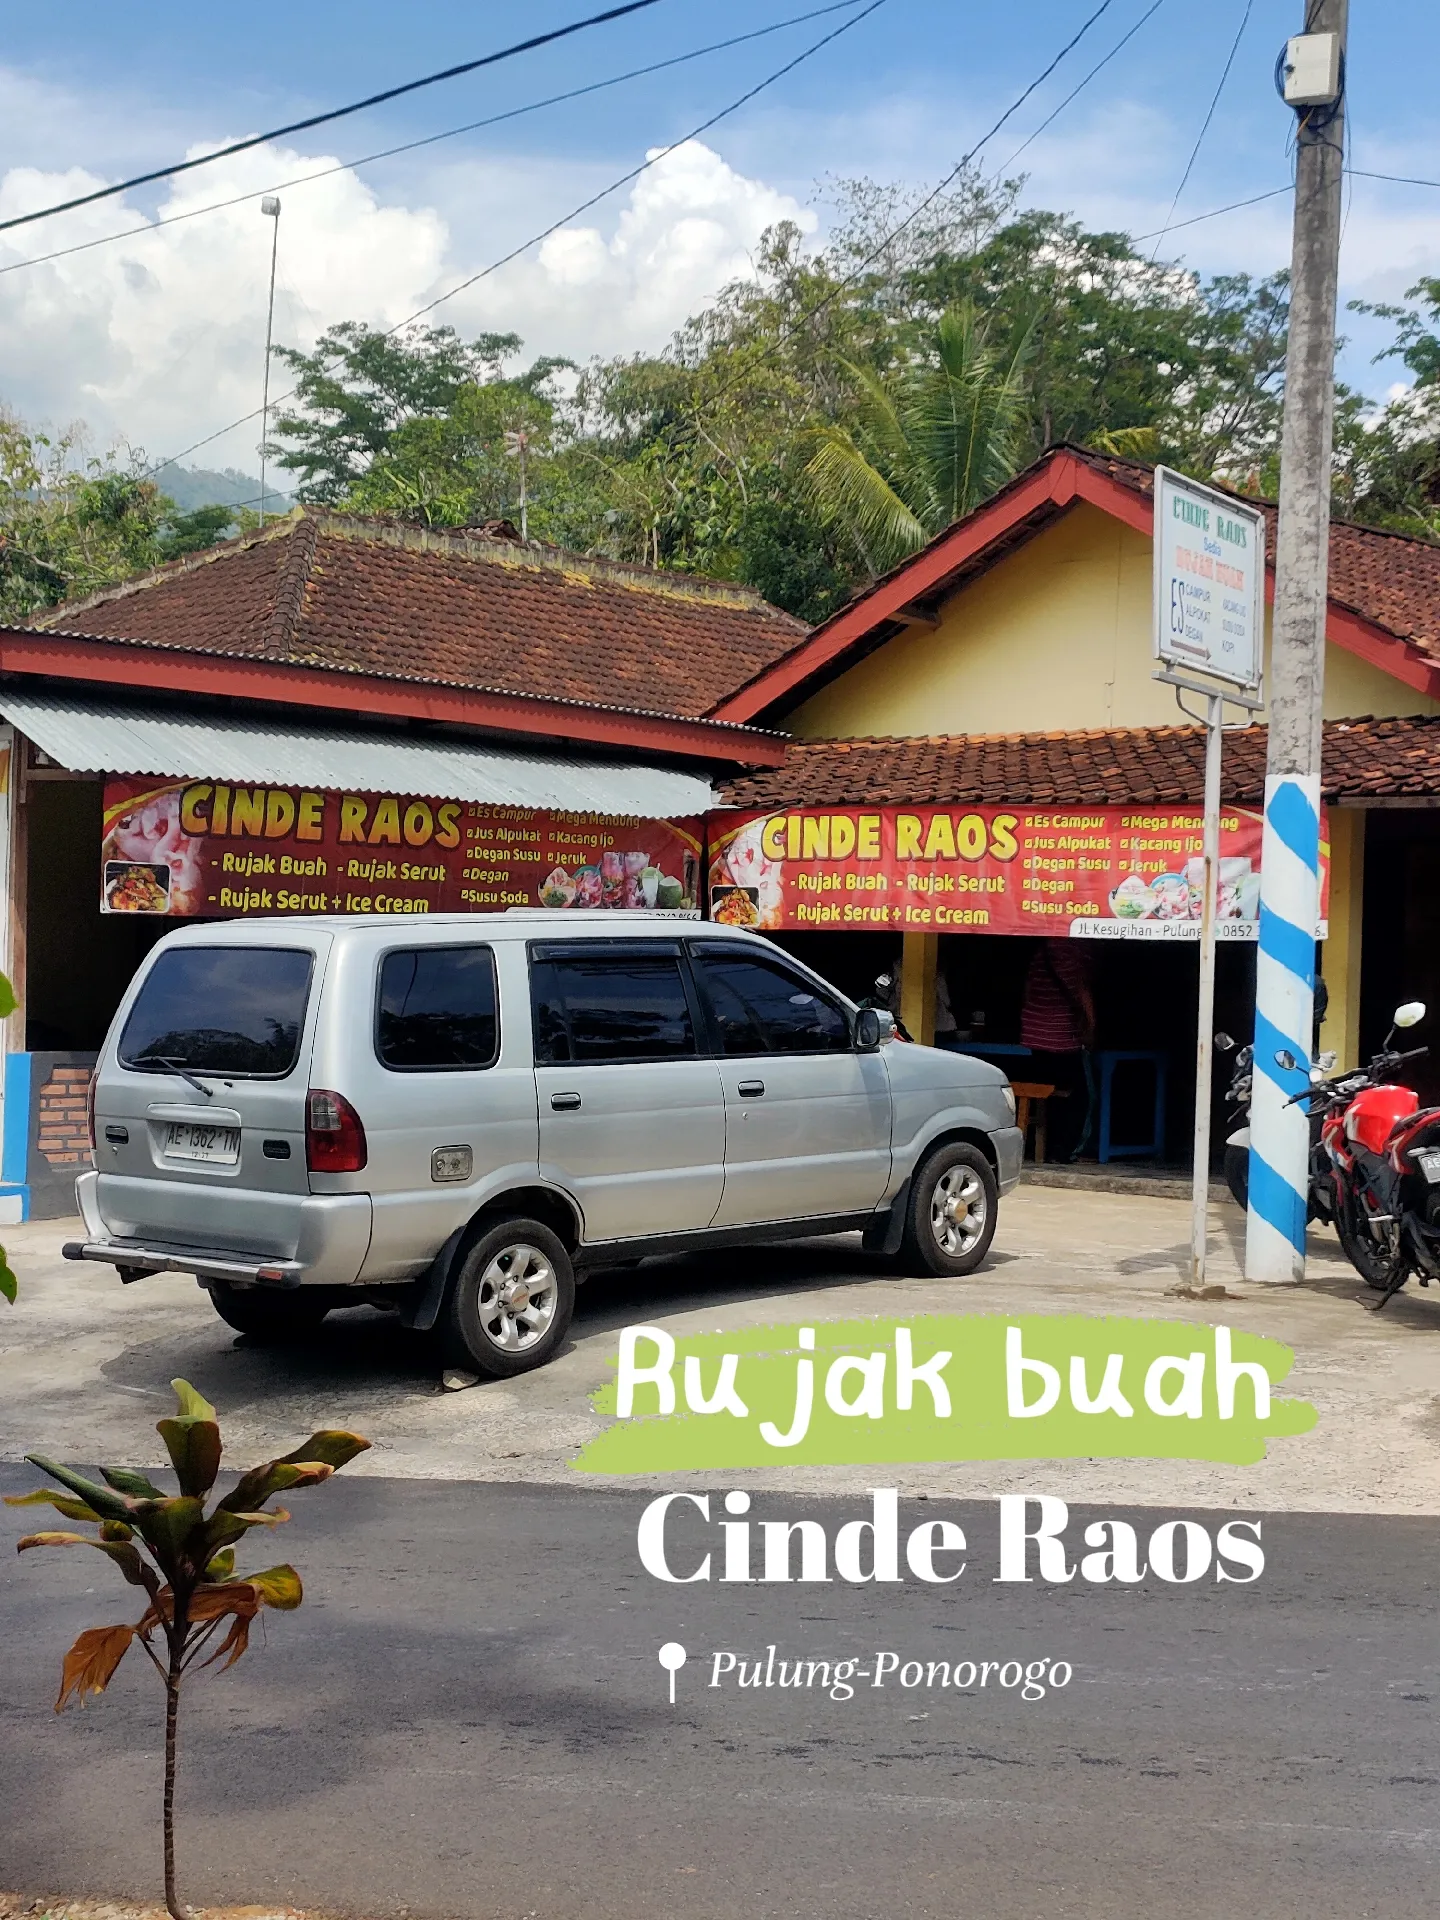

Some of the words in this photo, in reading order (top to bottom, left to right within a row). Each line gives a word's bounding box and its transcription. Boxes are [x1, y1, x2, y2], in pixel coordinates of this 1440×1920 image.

[1217, 515, 1247, 549] RAOS
[1171, 577, 1185, 634] ES
[181, 783, 325, 841] CINDE
[339, 796, 462, 848] RAOS
[476, 805, 490, 819] Es
[492, 806, 536, 822] Campur
[556, 811, 587, 827] Mega
[589, 812, 640, 829] Mendung
[1034, 815, 1050, 828] Es
[1052, 815, 1106, 831] Campur
[1130, 815, 1168, 832] Mega
[1172, 815, 1239, 832] Menng
[474, 826, 494, 840] Jus
[496, 827, 541, 843] Alpukat
[556, 830, 598, 848] Kacang
[600, 831, 614, 848] Ijo
[762, 814, 882, 861] CINDE
[896, 813, 1018, 861] RAOS
[1034, 836, 1056, 849] Jus
[1057, 836, 1112, 851] Alpukat
[1130, 836, 1182, 853] Kacang
[1185, 836, 1203, 853] Ijo
[474, 847, 511, 863] Degan
[513, 848, 541, 862] Susu
[555, 851, 587, 865] Jeruk
[222, 852, 274, 877] Rujak
[280, 854, 327, 876] Buah
[347, 859, 397, 882] Rujak
[400, 862, 446, 882] Serut
[1031, 857, 1075, 872] Degan
[1078, 857, 1111, 871] Susu
[1128, 858, 1167, 873] Jeruk
[471, 867, 509, 883] Degan
[798, 873, 842, 894] Rujak
[845, 873, 888, 891] Buah
[907, 873, 954, 894] Rujak
[958, 874, 1005, 893] Serut
[1031, 877, 1074, 893] Degan
[220, 887, 271, 912] Rujak
[276, 889, 327, 911] Serut
[346, 892, 371, 912] Ice
[375, 894, 429, 913] Cream
[468, 889, 498, 904] Susu
[500, 890, 529, 904] Soda
[797, 903, 841, 924] Rujak
[844, 904, 890, 922] Serut
[905, 906, 931, 924] Ice
[934, 905, 989, 925] Cream
[1031, 900, 1063, 914] Susu
[1066, 901, 1099, 915] Soda
[1092, 923, 1152, 939] Kesugihan
[1163, 923, 1202, 938] Pulung
[1223, 924, 1253, 937] 0852
[167, 1125, 184, 1145] AE
[189, 1126, 216, 1149] 1362
[223, 1129, 240, 1152] TN
